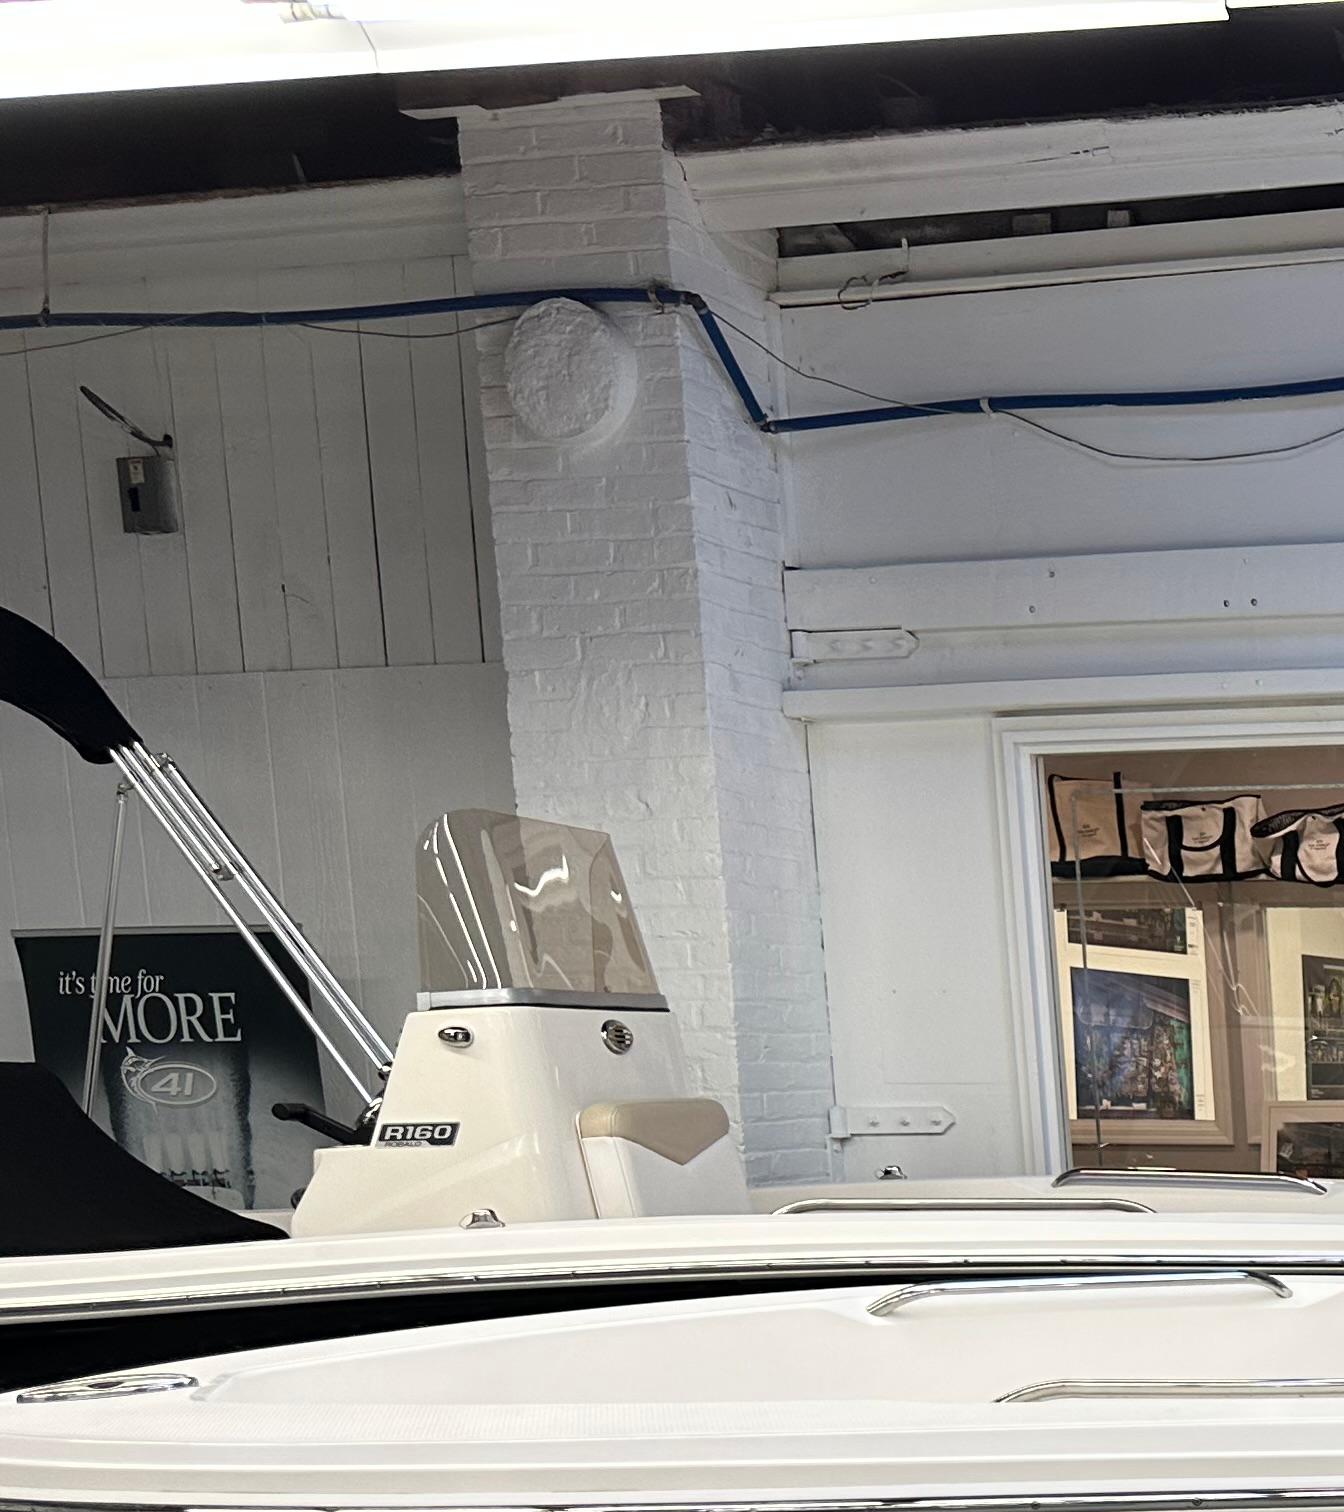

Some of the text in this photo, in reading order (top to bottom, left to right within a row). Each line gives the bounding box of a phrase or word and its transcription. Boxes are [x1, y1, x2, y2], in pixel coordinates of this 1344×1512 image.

[59, 968, 164, 999] it's tme for
[89, 991, 242, 1044] MORE
[150, 1072, 194, 1097] 41
[384, 1125, 453, 1141] R160
